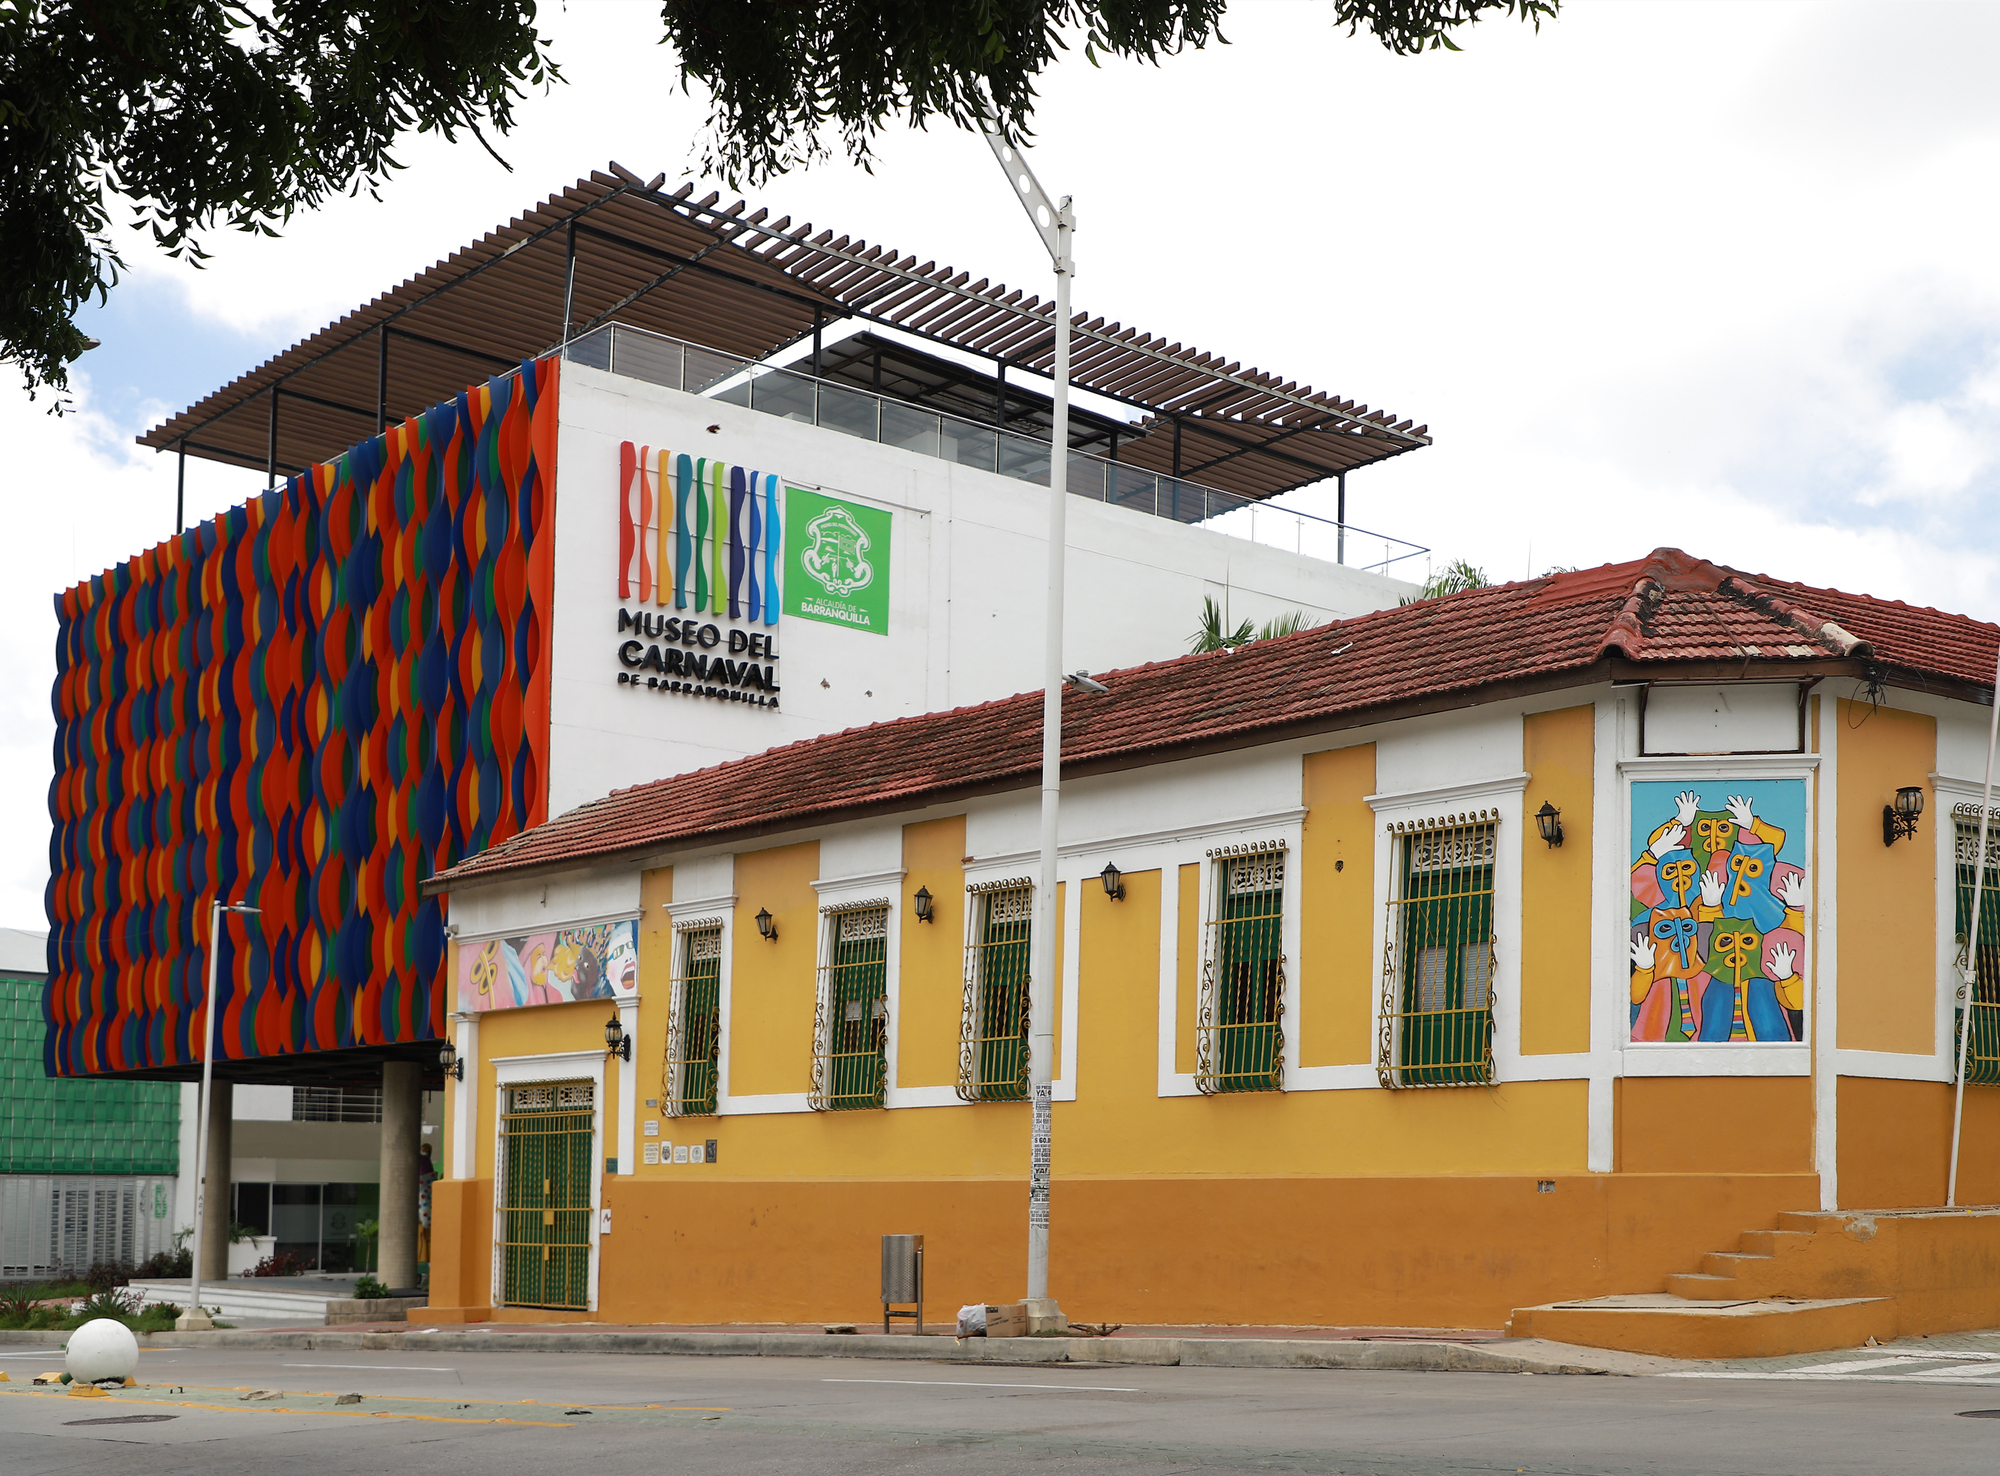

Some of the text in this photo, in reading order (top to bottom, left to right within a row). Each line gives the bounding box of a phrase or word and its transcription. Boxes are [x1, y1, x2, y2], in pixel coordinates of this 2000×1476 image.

[801, 601, 871, 626] BARRANQUILLA
[816, 597, 857, 613] ALCALDÍA DE
[618, 607, 780, 660] MUSEO DEL
[618, 640, 781, 692] CARNAVAL
[617, 672, 779, 708] DE BARRANQUILLA
